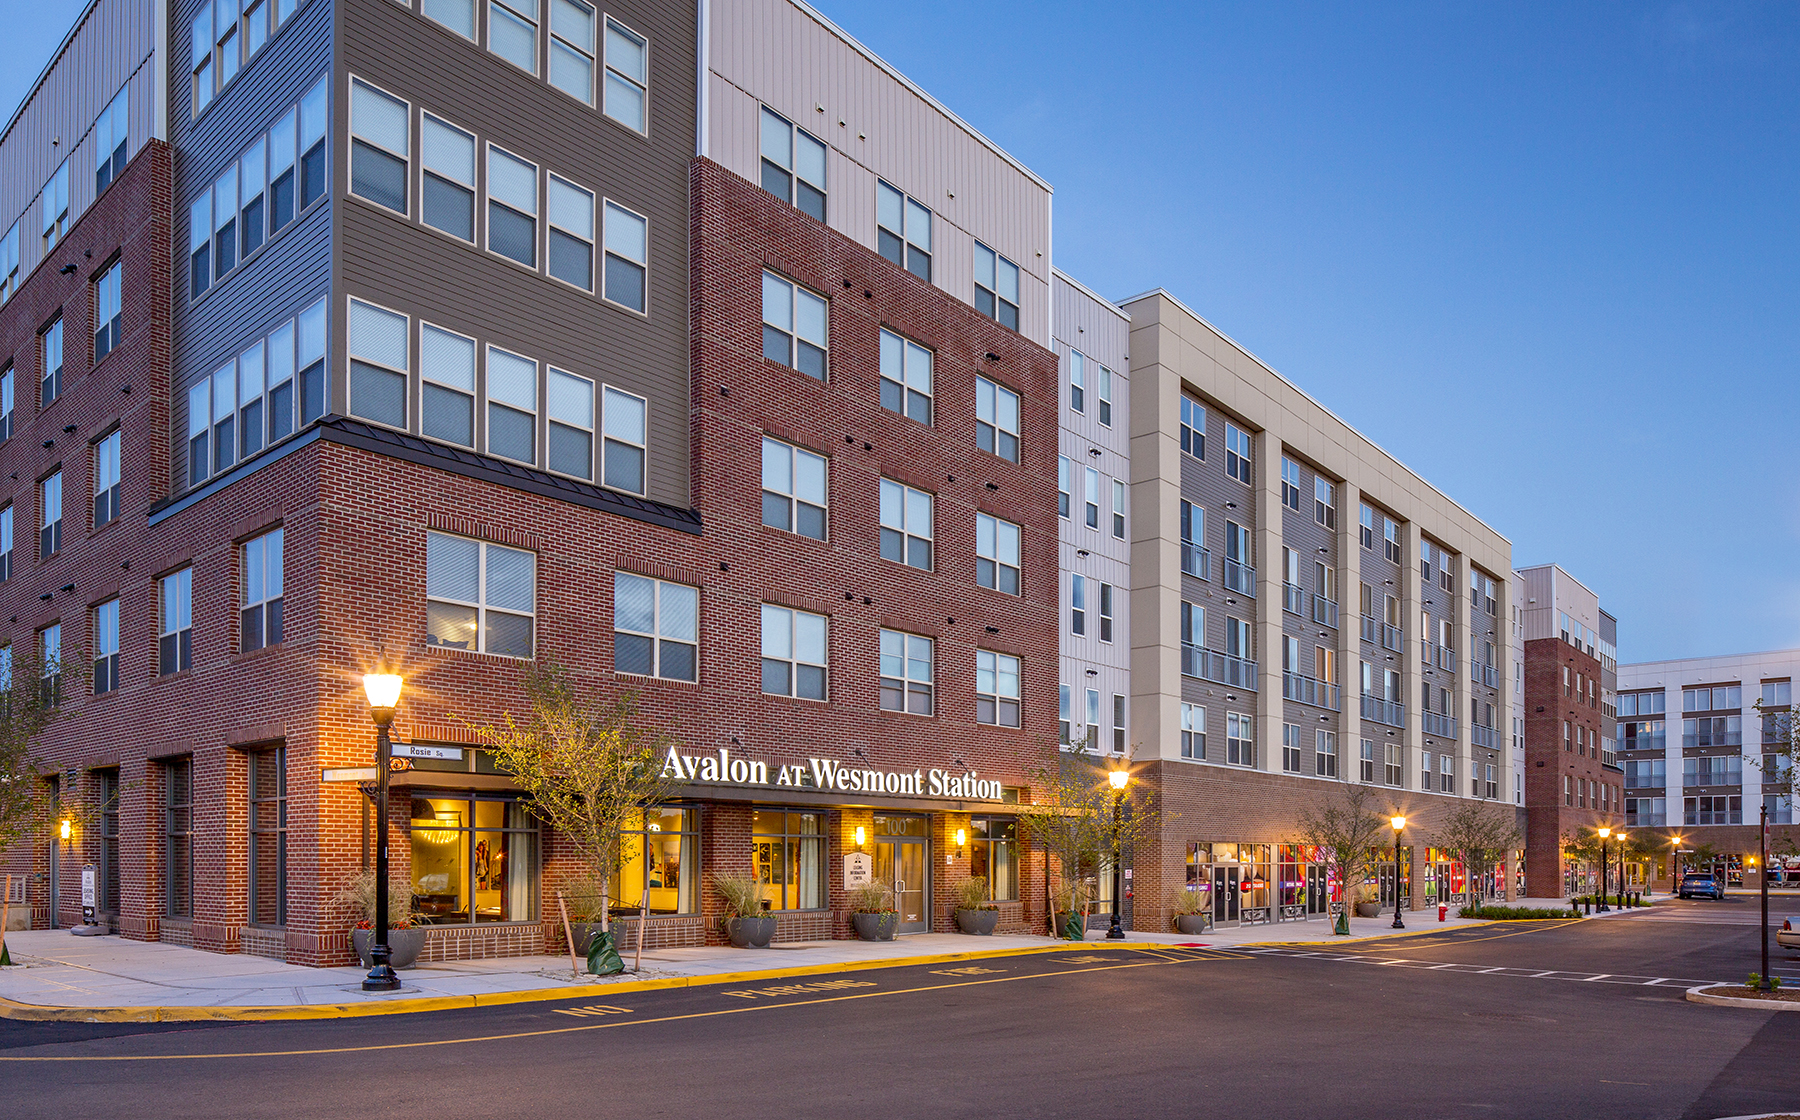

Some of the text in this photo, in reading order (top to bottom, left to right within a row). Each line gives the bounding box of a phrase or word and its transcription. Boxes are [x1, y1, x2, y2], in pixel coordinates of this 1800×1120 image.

[410, 746, 432, 756] Rosie
[660, 745, 1003, 800] Avalon AT Wesmont Station
[886, 819, 907, 835] 100
[551, 1004, 634, 1018] NO
[721, 979, 878, 999] PARKING
